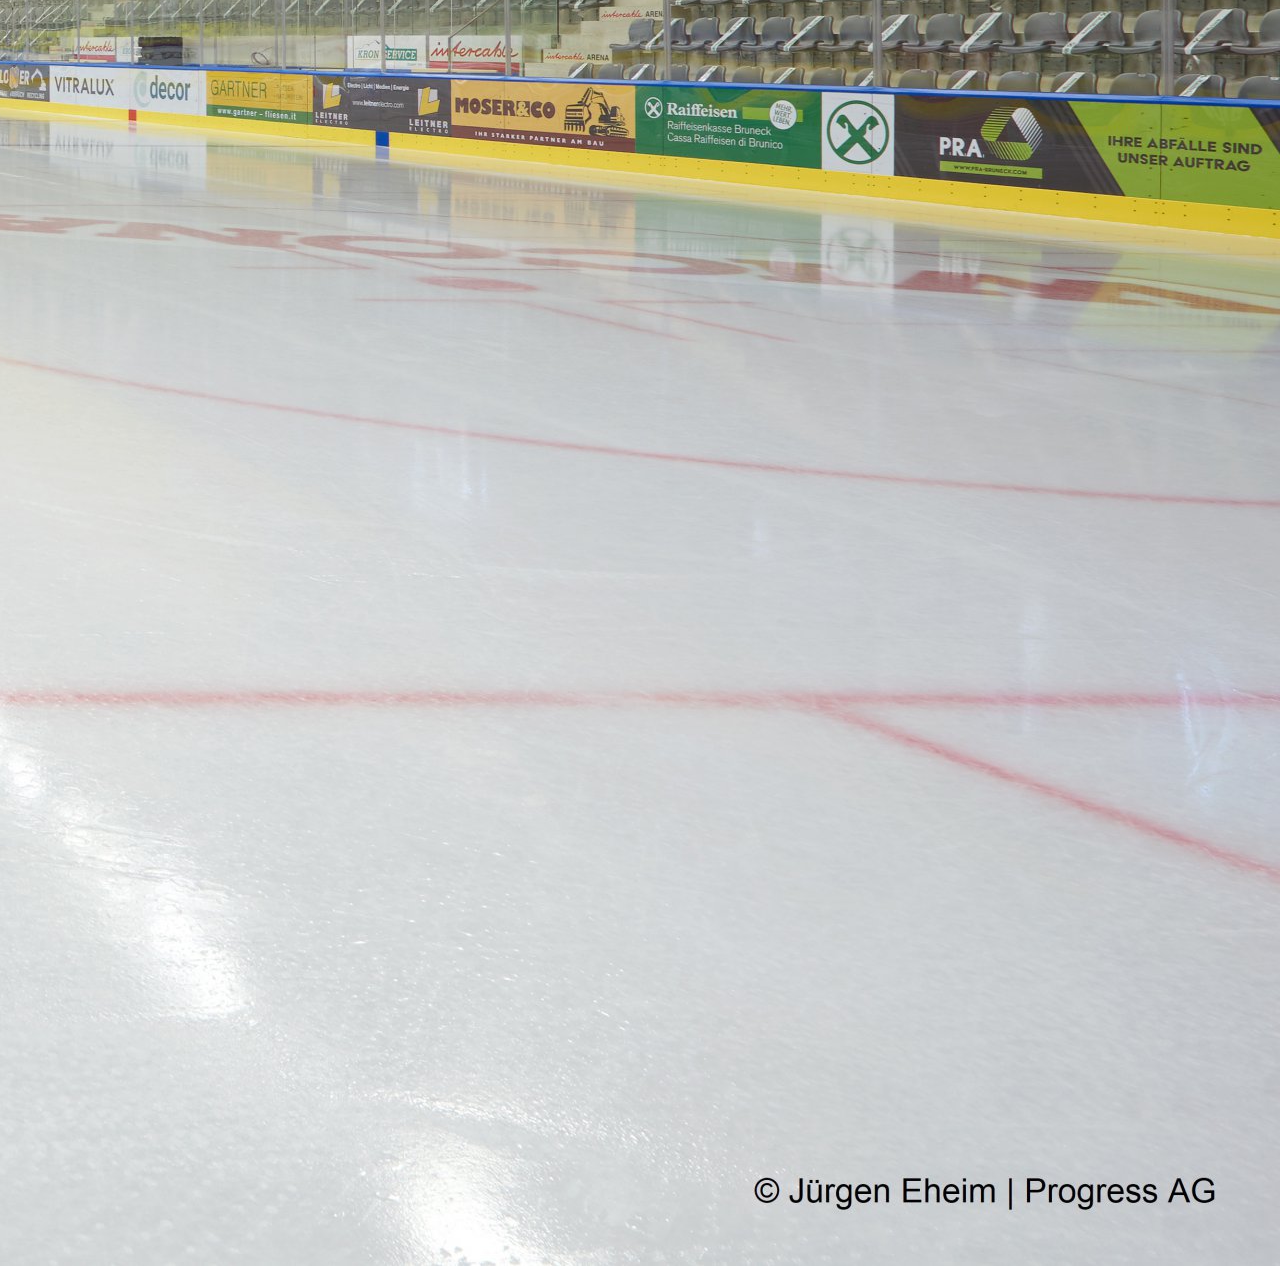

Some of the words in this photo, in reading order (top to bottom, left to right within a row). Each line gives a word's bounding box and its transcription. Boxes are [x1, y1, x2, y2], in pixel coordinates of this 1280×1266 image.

[54, 76, 115, 96] VITRALUX
[211, 79, 267, 99] GARTNER
[315, 111, 348, 120] LEITNER
[455, 97, 556, 119] MOSER&CO
[667, 102, 738, 119] Raiffeisen
[409, 118, 449, 129] LEITNER
[409, 126, 449, 134] ELECTRO
[667, 121, 732, 134] Raiffeisenkasse
[734, 125, 772, 136] Bruneck
[529, 135, 567, 144] PARTNER
[667, 133, 692, 143] Cassa
[694, 134, 736, 146] Raiffeisen
[738, 137, 746, 146] di
[748, 138, 783, 150] Brunico
[1108, 135, 1143, 149] IHRE
[1147, 135, 1216, 154] ABFÄLLE
[1221, 142, 1263, 156] SIND
[953, 164, 1027, 176] WWW.PRA-BRUNECK.COM
[1118, 152, 1168, 166] UNSER
[1173, 157, 1251, 172] AUFTRAG
